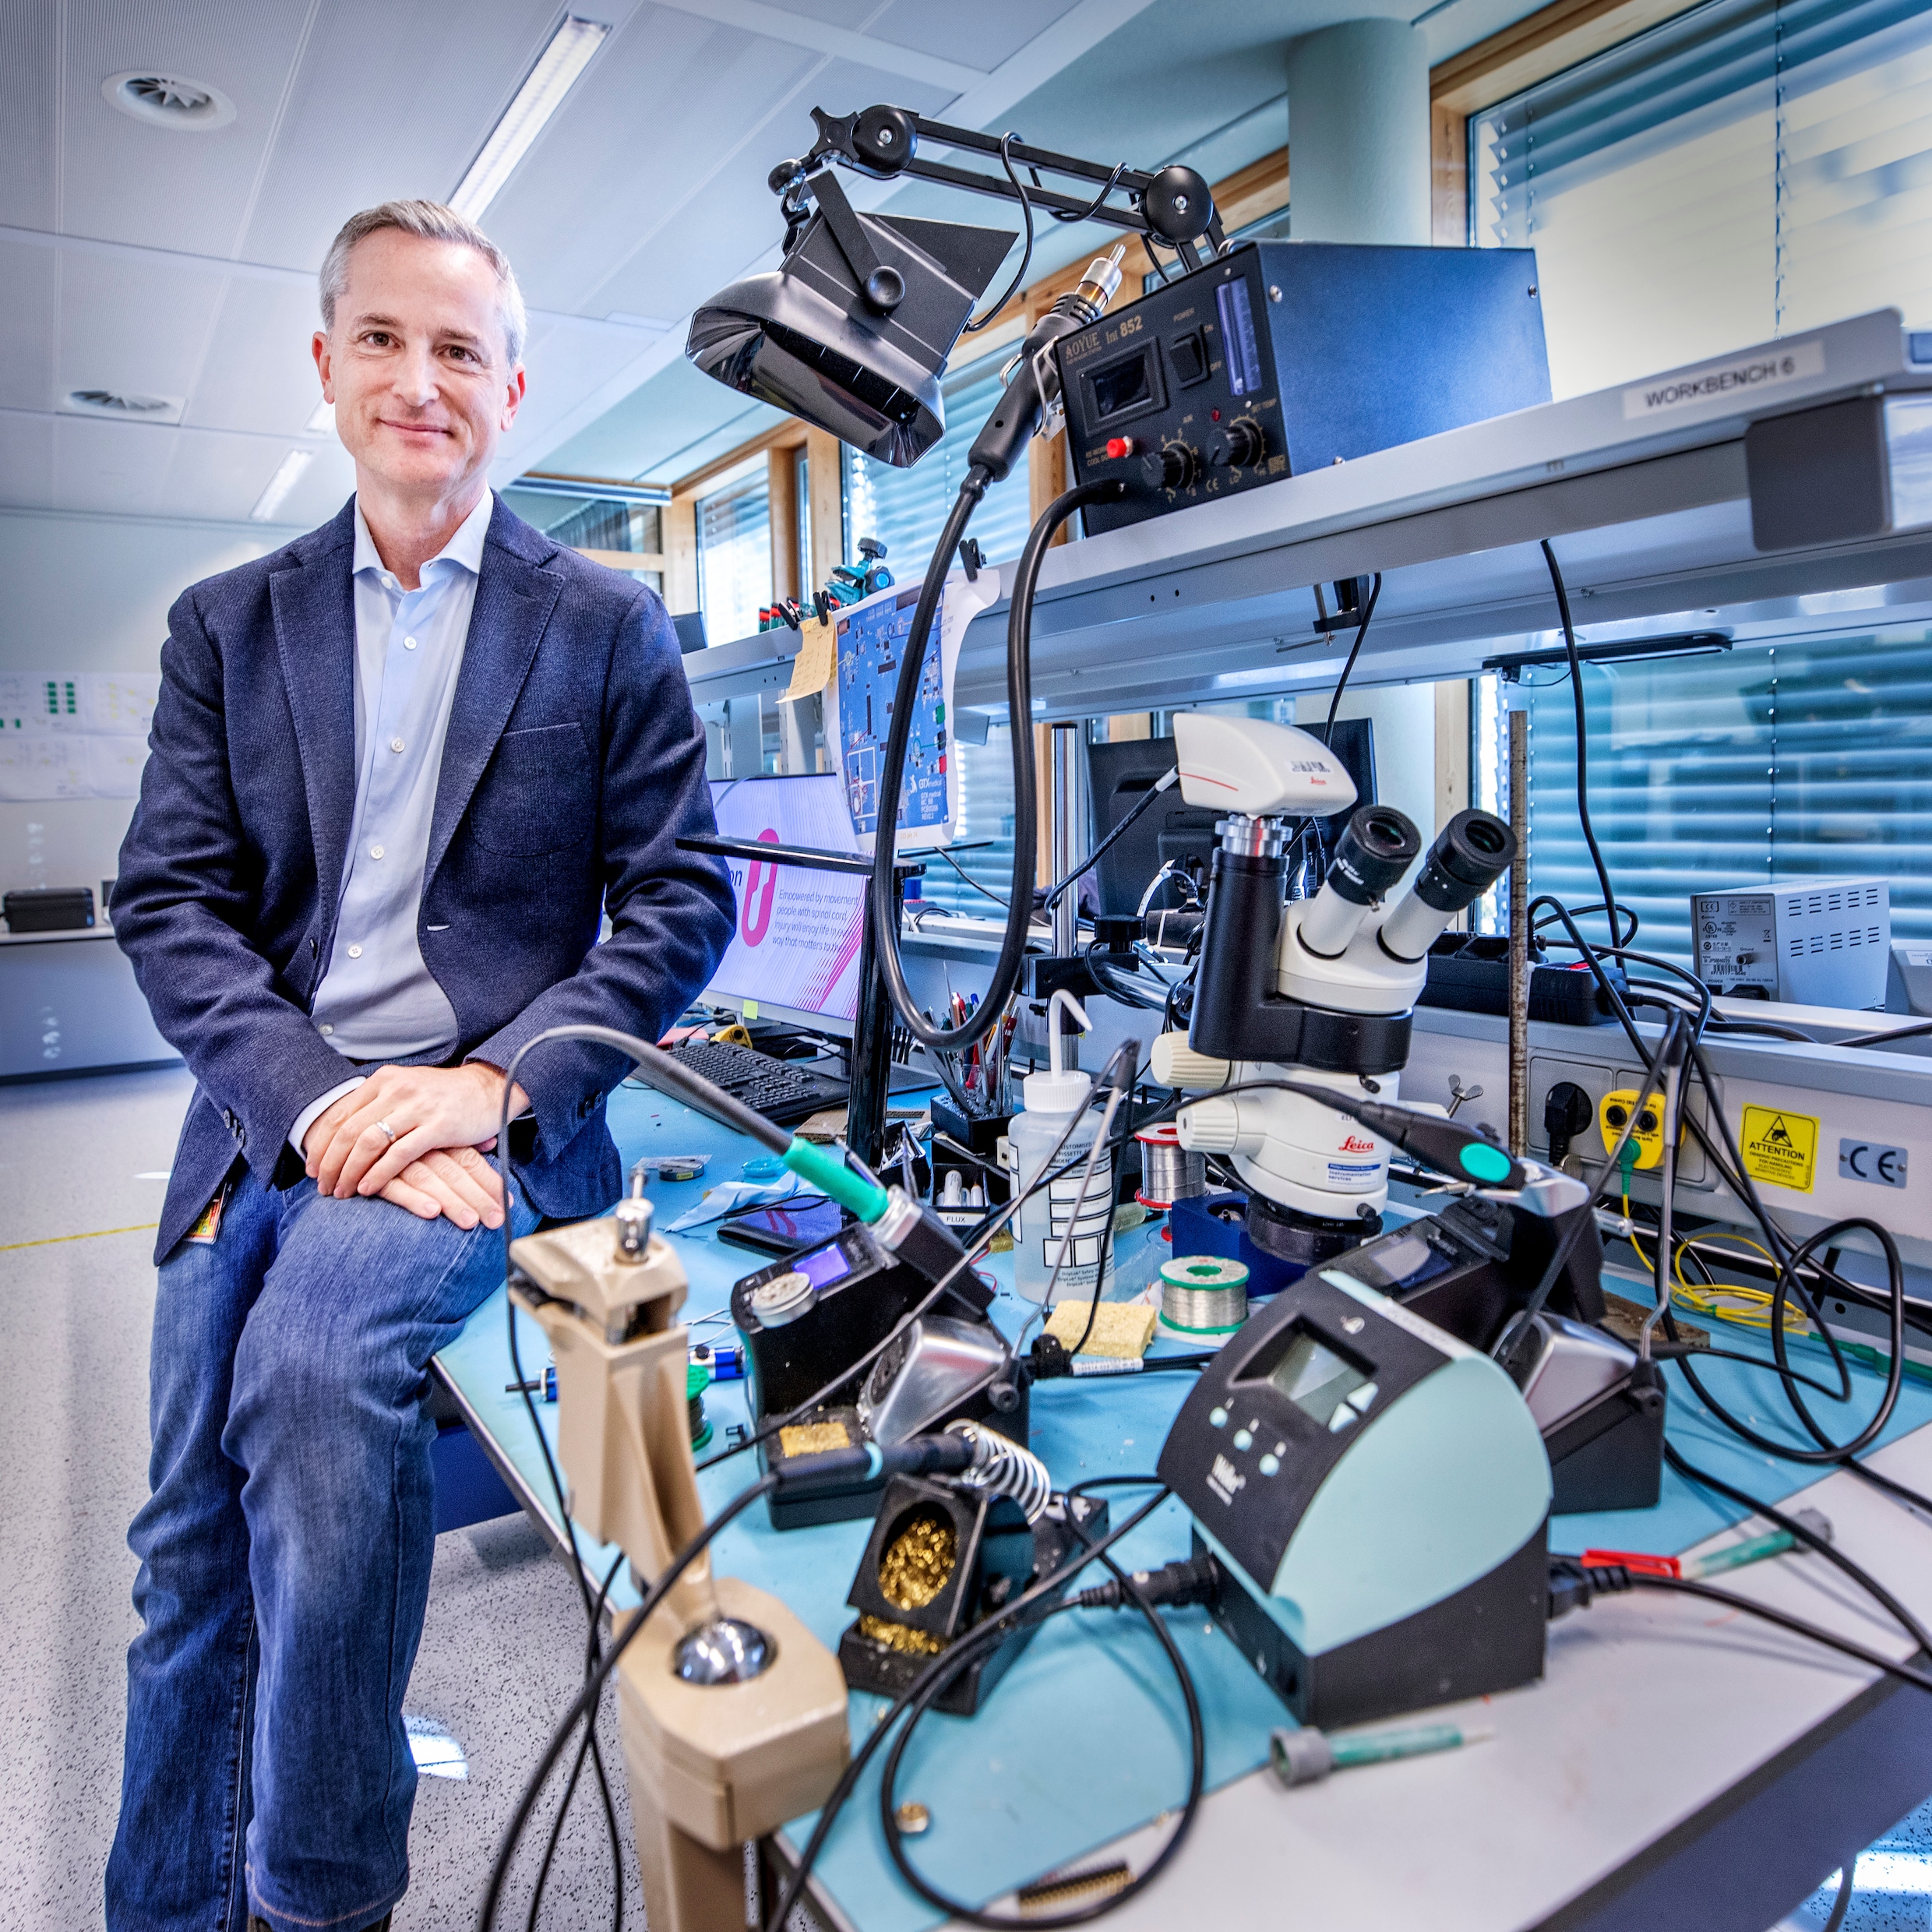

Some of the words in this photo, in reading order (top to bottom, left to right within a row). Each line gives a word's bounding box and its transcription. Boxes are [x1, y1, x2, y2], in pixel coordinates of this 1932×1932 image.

[1066, 331, 1100, 359] AOYUE
[1119, 316, 1143, 337] 852
[1645, 363, 1777, 407] WORKBENCH
[1782, 357, 1796, 375] 6
[779, 890, 815, 902] Empowered
[815, 892, 823, 905] by
[777, 906, 797, 918] people
[798, 906, 811, 916] with
[812, 909, 831, 919] spinal
[774, 922, 791, 933] injury
[791, 922, 802, 933] will
[802, 925, 820, 936] enjoy
[820, 924, 830, 933] life
[772, 936, 784, 947] way
[785, 936, 798, 947] that
[799, 940, 823, 950] matters
[1338, 1135, 1374, 1153] Leica
[1749, 1141, 1805, 1161] ATTENTION
[1749, 1151, 1771, 1160] OBSERVE
[1771, 1156, 1803, 1167] PRECAUTIONS
[1769, 1161, 1793, 1170] HANDLING
[1850, 1146, 1896, 1183] CE
[1754, 1167, 1775, 1176] SENSITIVE
[1776, 1171, 1796, 1179] DEVICES
[1758, 1164, 1791, 1175] ELECTROSTATIC
